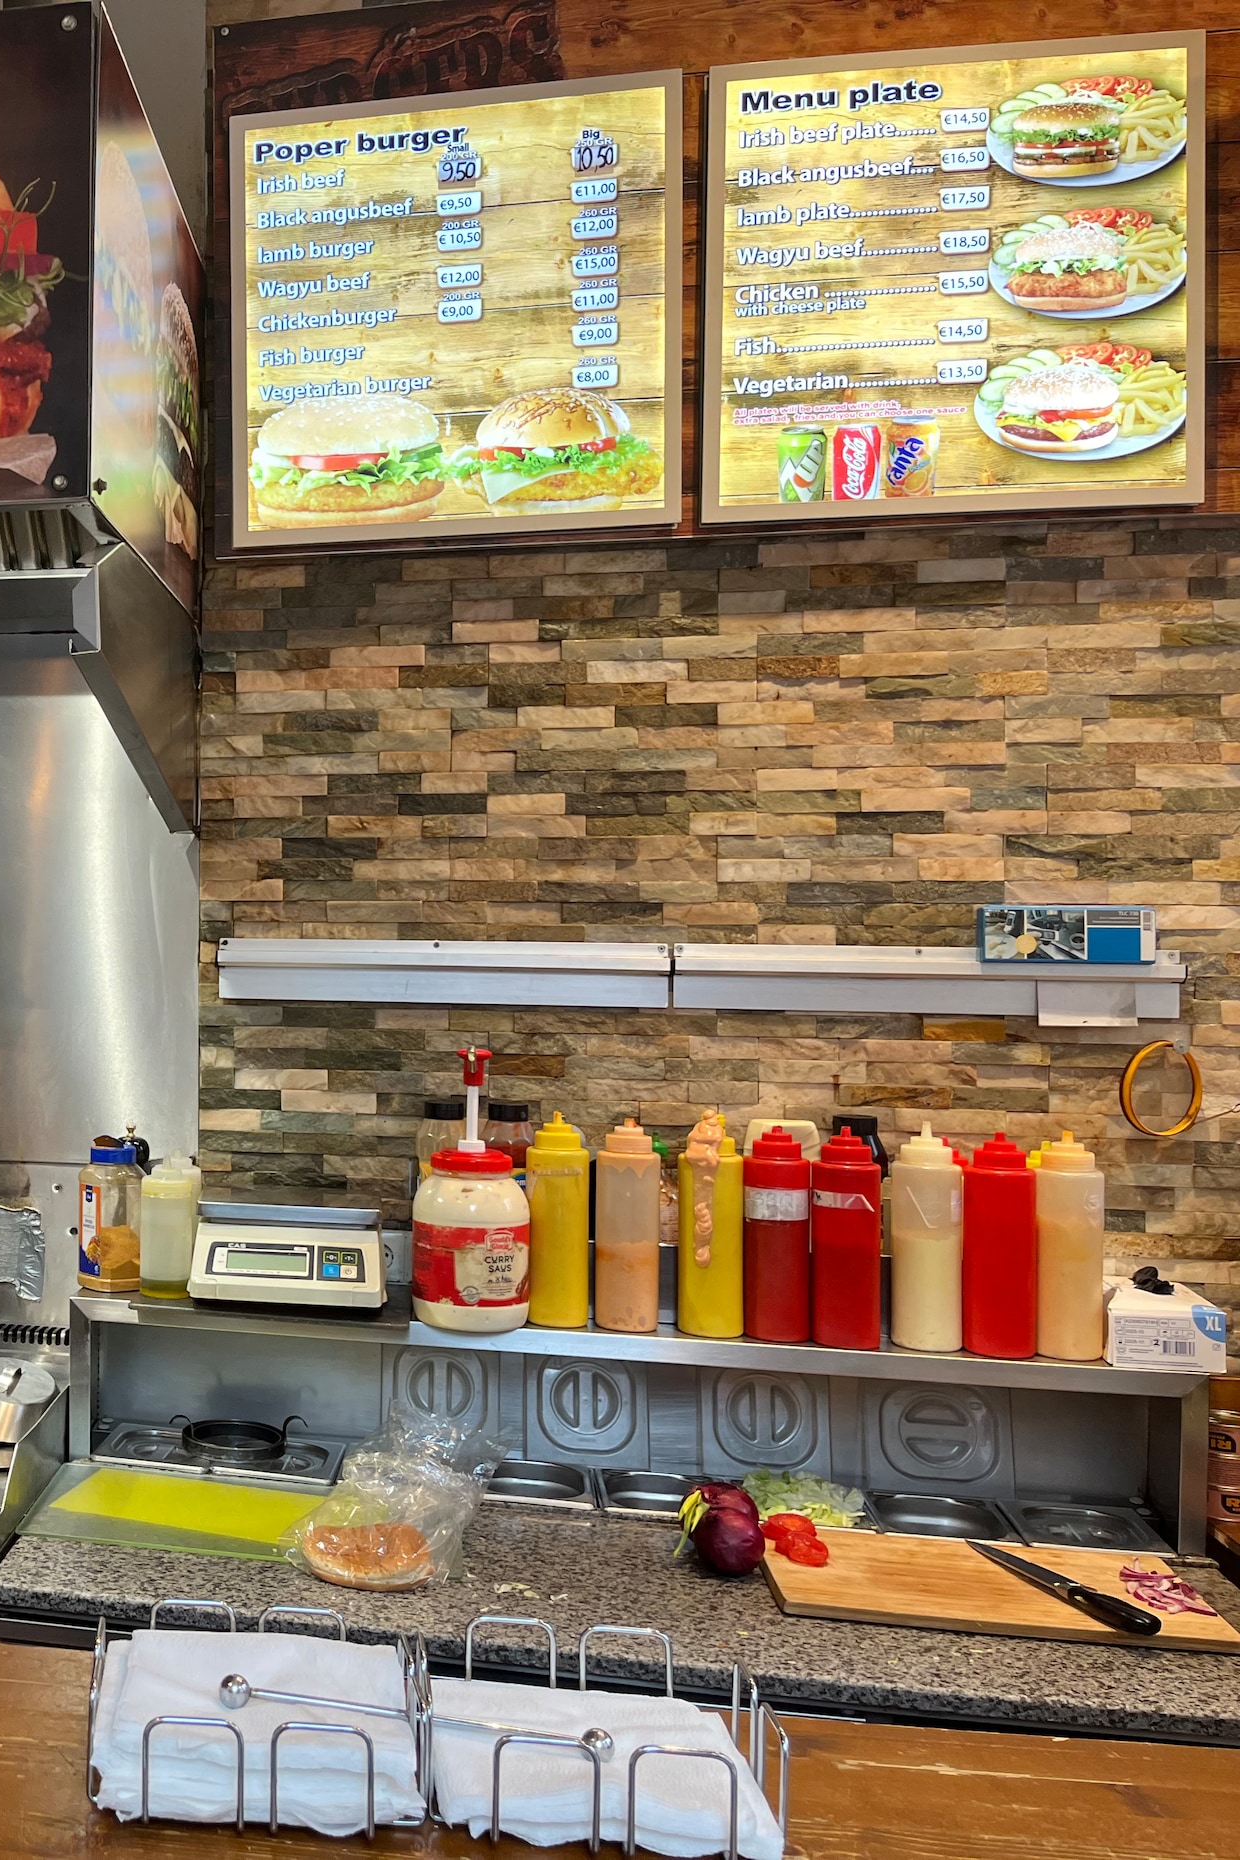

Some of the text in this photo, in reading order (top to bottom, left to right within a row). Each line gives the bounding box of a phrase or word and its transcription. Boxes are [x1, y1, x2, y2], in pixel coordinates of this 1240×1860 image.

[741, 80, 940, 112] Menu plate
[943, 111, 987, 125] €14,50
[582, 129, 600, 140] Big
[738, 127, 784, 148] Irish
[789, 123, 837, 143] beef
[255, 127, 467, 163] Poper burger
[447, 143, 469, 153] Small
[597, 137, 613, 146] GR
[942, 151, 985, 164] €16,50
[442, 161, 476, 182] 9,50
[738, 166, 795, 188] Black
[257, 168, 345, 194] Irish beef
[575, 182, 616, 197] €11,00
[440, 197, 472, 211] €9,50
[942, 191, 985, 204] €17,50
[257, 197, 413, 229] Black angusbeef
[579, 207, 617, 218] 260 GR
[442, 219, 479, 231] 200 GR
[574, 219, 614, 233] €12,00
[943, 235, 986, 248] €18,50
[309, 239, 375, 260] burger
[579, 245, 617, 256] 260 GR
[736, 246, 809, 267] Wagyu
[575, 257, 616, 270] €15,00
[441, 271, 479, 283] €12,00
[579, 278, 617, 289] 260 GR
[941, 276, 984, 289] €15,50
[257, 271, 370, 300] Wagyu beef
[443, 291, 480, 302] 200 GR
[735, 283, 819, 304] Chicken
[574, 294, 615, 307] €11,00
[735, 297, 866, 317] with cheese plate
[442, 305, 473, 318] €9,00
[258, 308, 397, 333] Chickenburger
[599, 314, 616, 323] GR
[578, 328, 612, 341] €9,00
[939, 324, 982, 337] €14,50
[259, 345, 364, 367] Fish burger
[599, 355, 616, 364] GR
[576, 370, 609, 383] €8,00
[939, 366, 982, 379] €13,50
[259, 376, 431, 403] Vegetarian burger
[734, 409, 747, 417] All
[749, 407, 777, 417] plates
[781, 405, 797, 414] will
[800, 405, 811, 413] be
[814, 403, 846, 412] served
[850, 402, 869, 410] with
[734, 416, 759, 425] extra
[794, 413, 816, 422] fries
[819, 412, 836, 420] and
[838, 411, 855, 421] you
[858, 411, 876, 419] can
[879, 408, 913, 417] choose
[916, 407, 934, 416] one
[937, 405, 967, 414] sauce
[485, 1255, 515, 1264] CURRY
[488, 1264, 512, 1273] SAUS
[1205, 1316, 1222, 1331] XL
